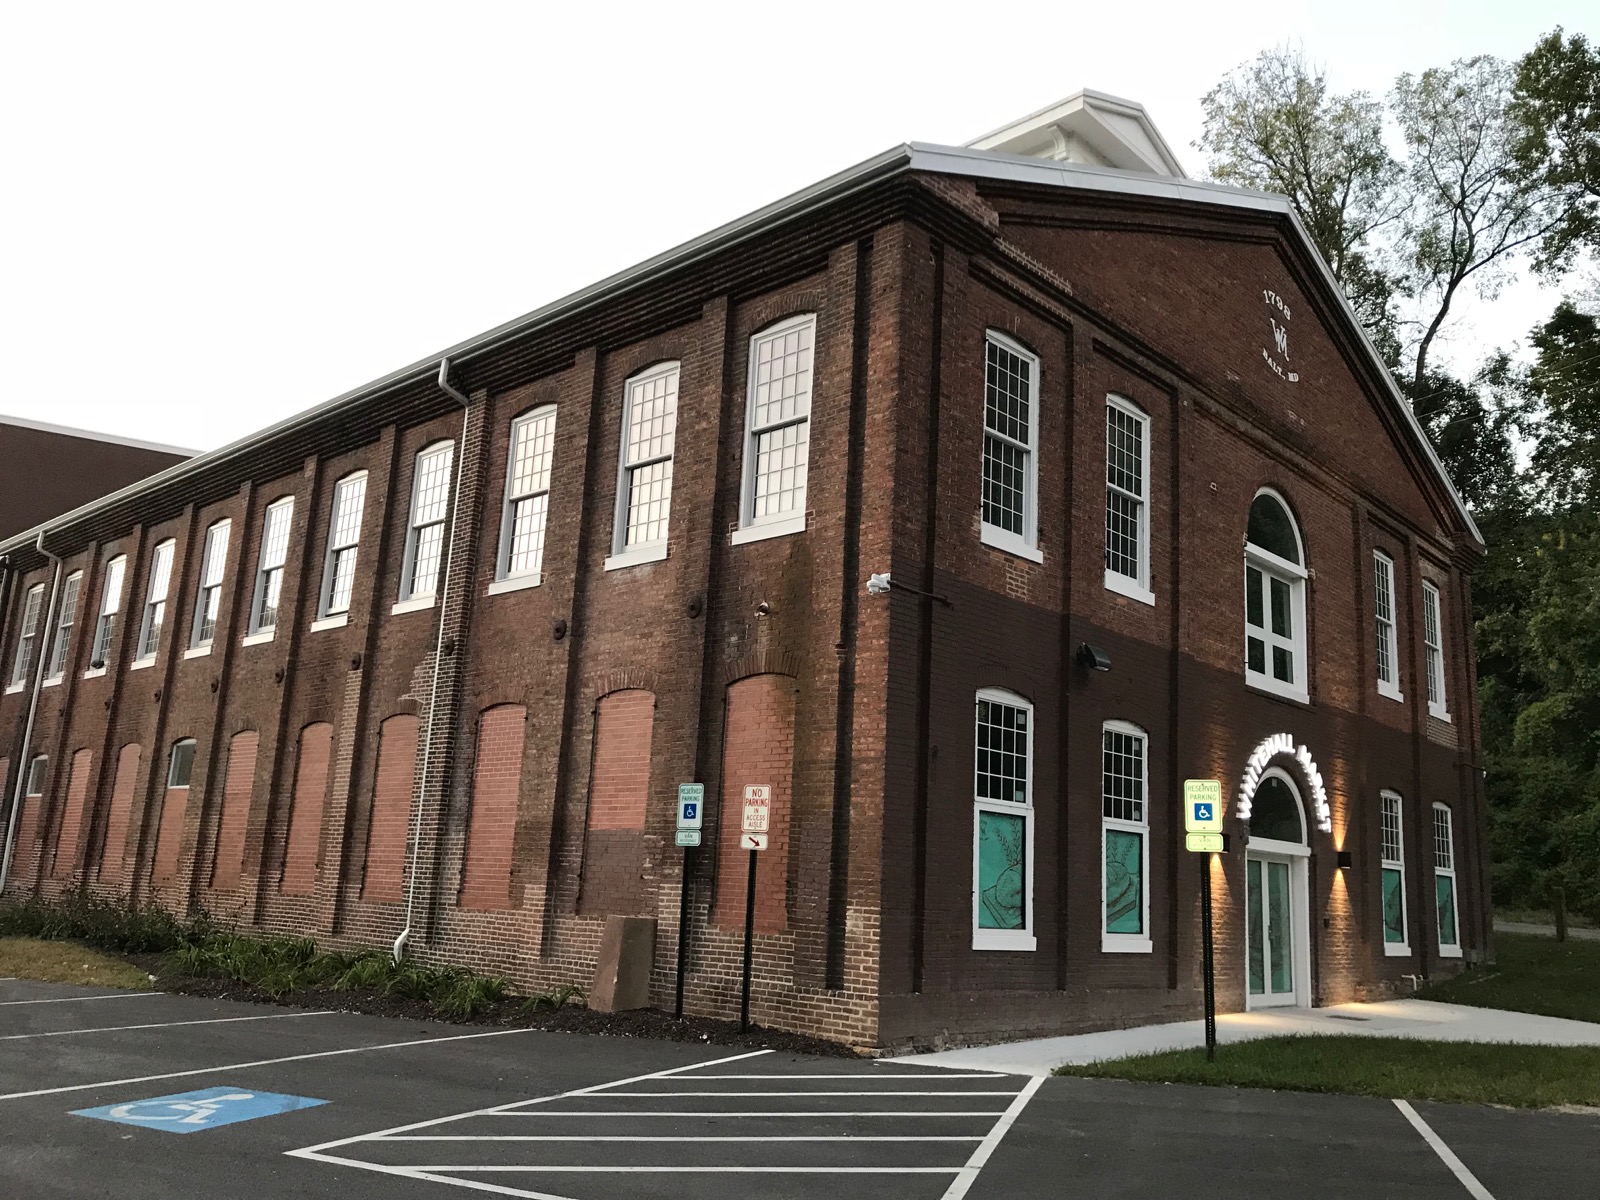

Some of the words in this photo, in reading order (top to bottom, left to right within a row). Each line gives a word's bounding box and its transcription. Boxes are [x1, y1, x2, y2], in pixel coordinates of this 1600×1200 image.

[1263, 289, 1291, 321] 1798
[1287, 372, 1299, 382] MD
[1236, 733, 1295, 819] WHITEHALL
[752, 788, 763, 797] NO
[1188, 785, 1218, 793] RESERVED
[745, 798, 768, 807] PARKING
